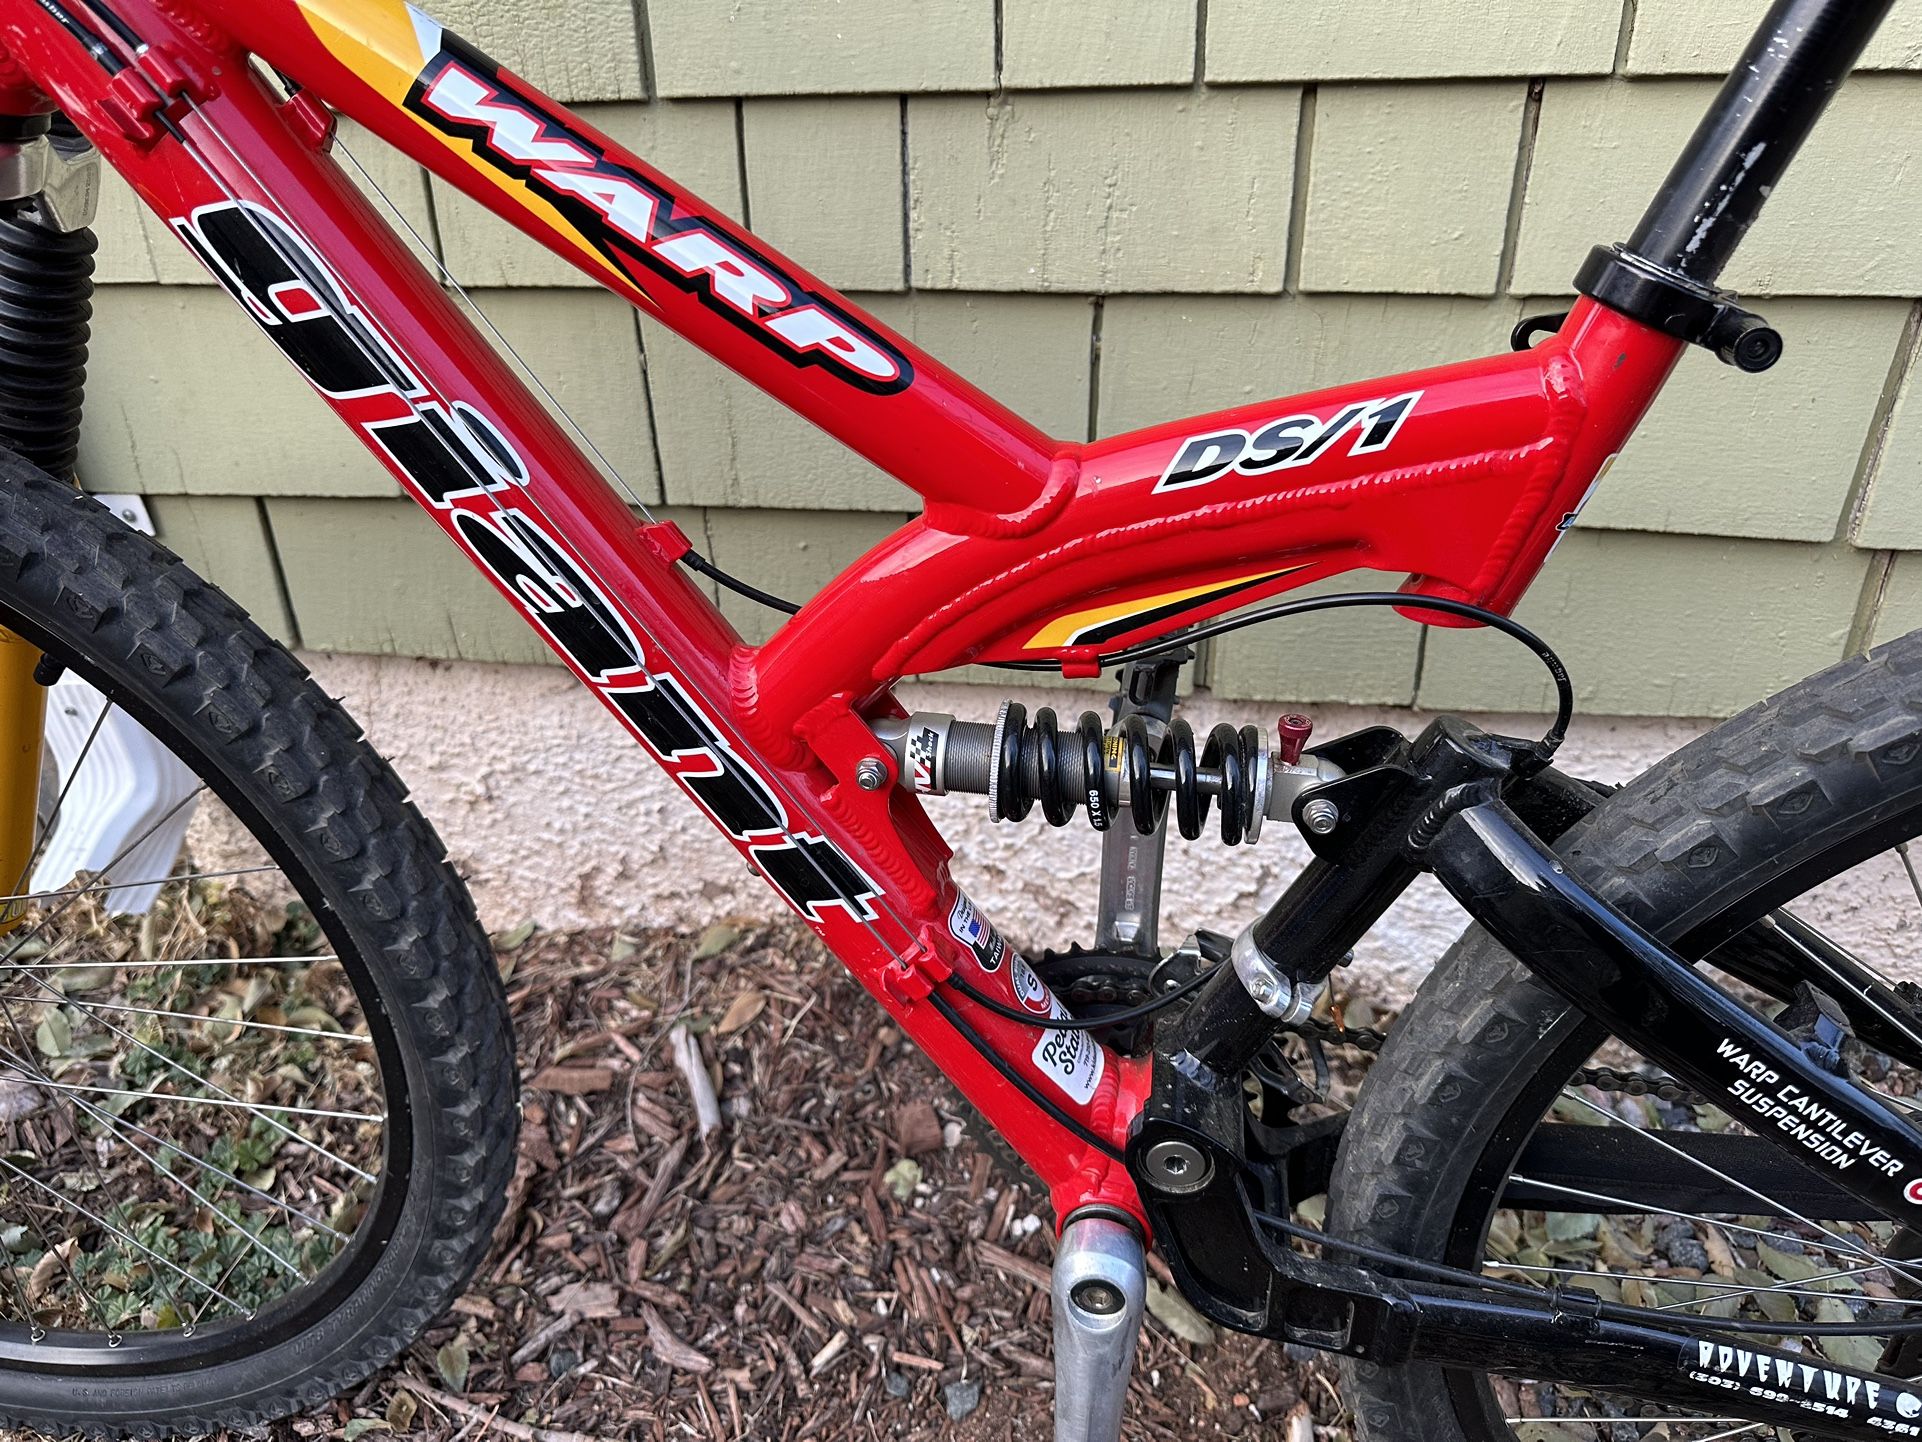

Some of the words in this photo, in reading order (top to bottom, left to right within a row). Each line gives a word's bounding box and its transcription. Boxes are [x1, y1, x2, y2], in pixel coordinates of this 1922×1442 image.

[424, 62, 900, 382] WARP
[1151, 390, 1424, 494] DS/1
[1088, 789, 1100, 809] 650
[959, 924, 966, 933] IN
[964, 911, 972, 924] THE
[990, 936, 1003, 965] TAIWA
[1015, 975, 1024, 997] DUAL
[1027, 974, 1038, 991] S
[1716, 1038, 1780, 1084] WARP
[1776, 1084, 1905, 1177] CANTILEVER
[1727, 1079, 1858, 1170] SUSPENSION
[1698, 1340, 1880, 1410] ADVENTURE
